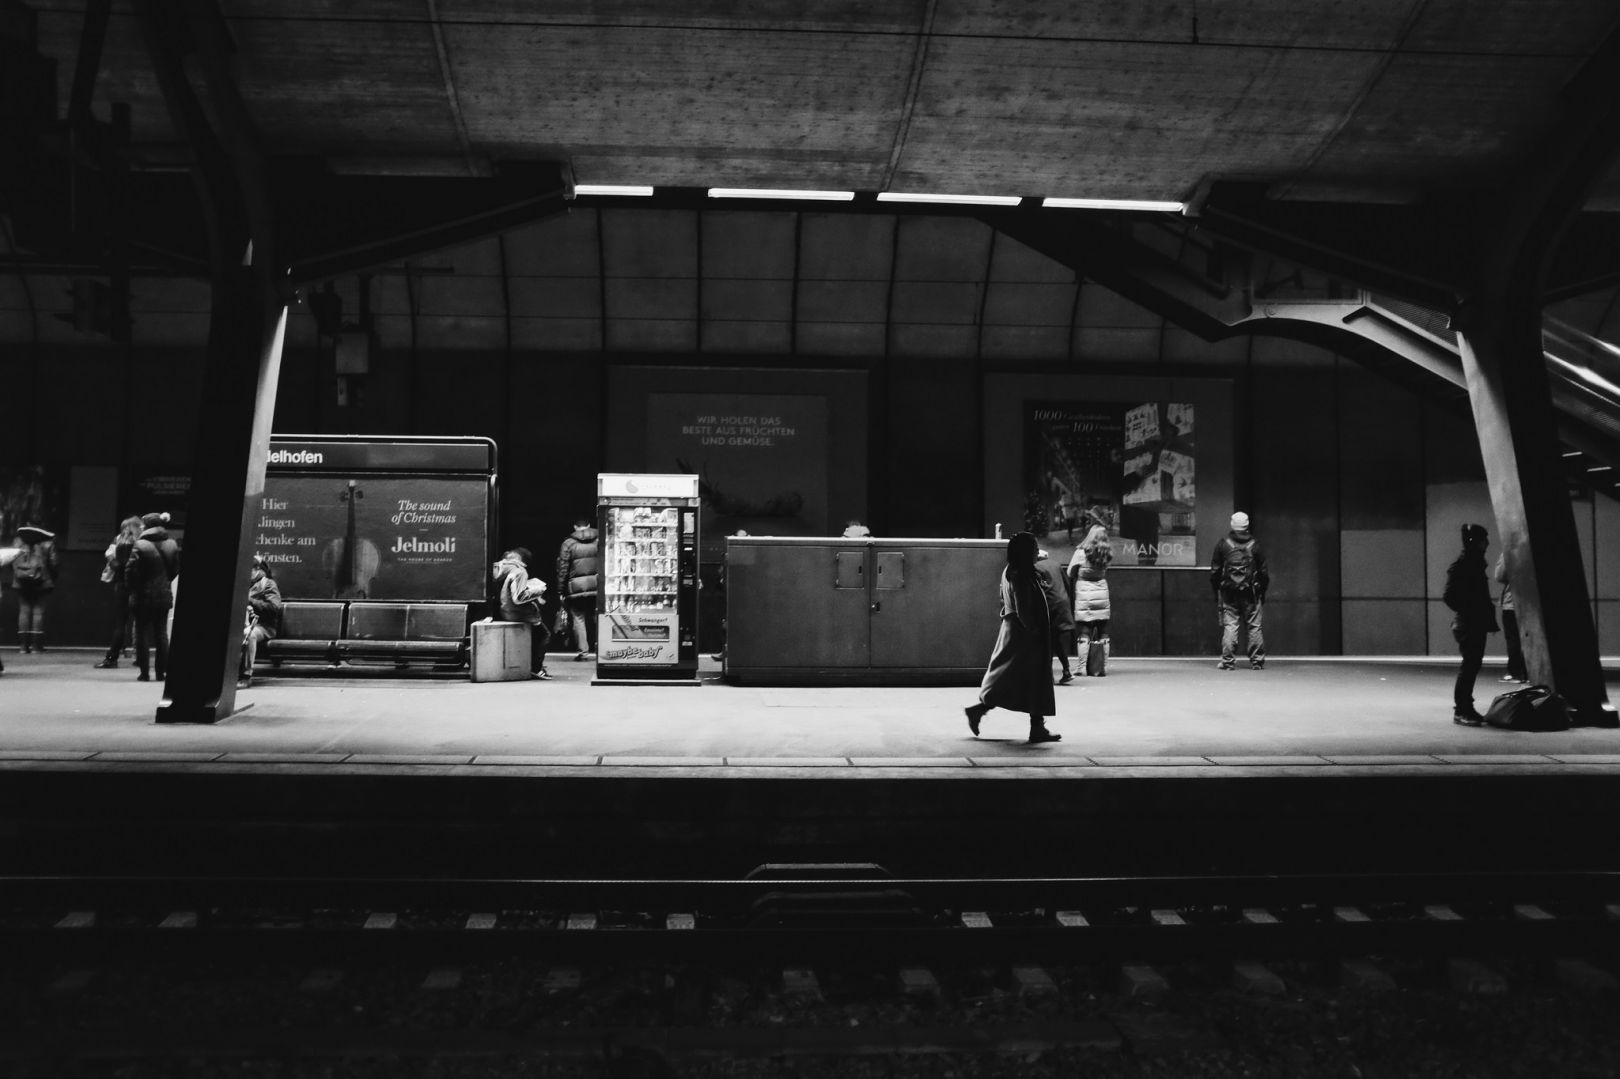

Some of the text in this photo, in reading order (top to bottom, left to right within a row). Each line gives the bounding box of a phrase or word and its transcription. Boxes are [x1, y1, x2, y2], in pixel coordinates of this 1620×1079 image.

[696, 415, 781, 426] WIR HOLEN DAS
[1033, 409, 1062, 421] 1000
[682, 424, 795, 436] BESTE AUS FRÜCHTEN
[1072, 421, 1093, 433] 100
[701, 436, 726, 446] UND
[397, 499, 451, 511] The sound
[258, 515, 296, 530] lingen
[391, 511, 457, 525] of Christmas
[297, 537, 316, 546] am
[391, 536, 456, 553] Jelmoli
[1122, 543, 1184, 556] MANOR
